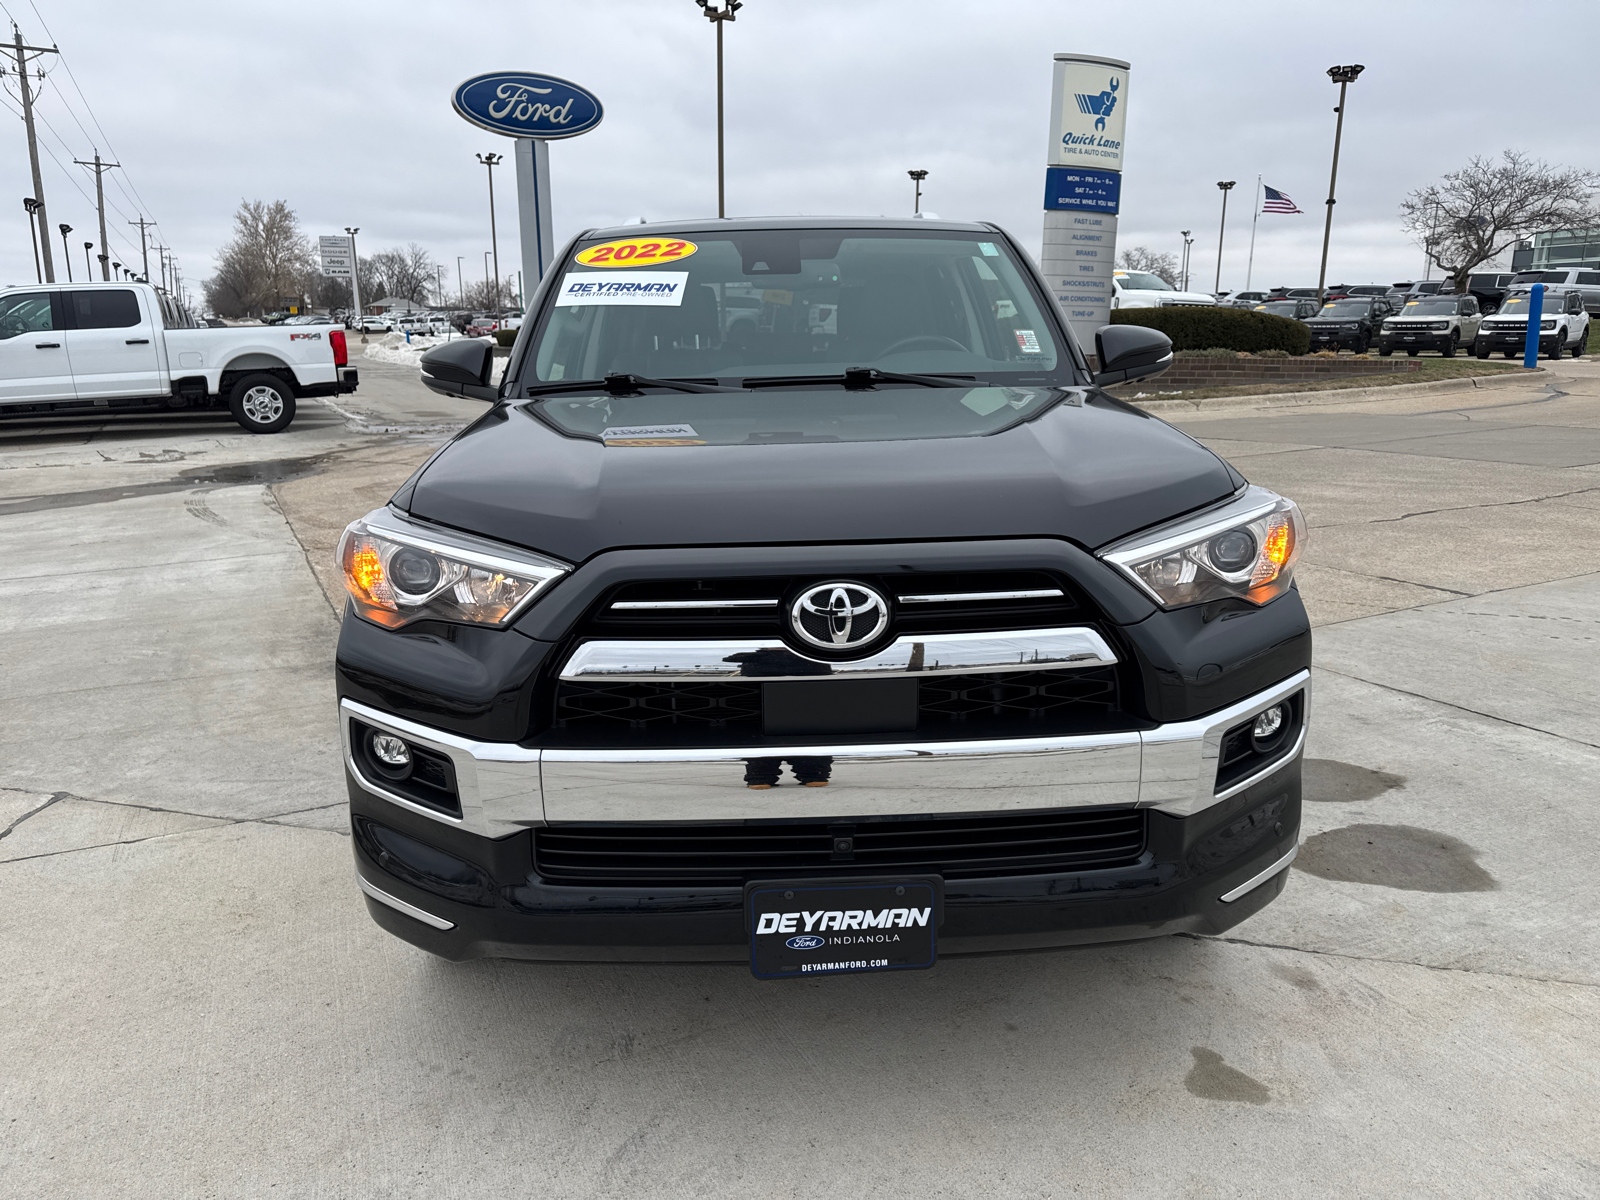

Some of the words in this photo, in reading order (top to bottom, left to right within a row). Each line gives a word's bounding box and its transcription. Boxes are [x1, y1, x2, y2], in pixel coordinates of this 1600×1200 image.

[488, 82, 574, 125] Ford
[1062, 132, 1097, 146] Quick
[1097, 135, 1121, 149] Lane
[1100, 150, 1119, 159] CENTER
[1058, 197, 1080, 205] SERVICE
[1072, 234, 1102, 242] ALIGNMENT
[587, 241, 687, 264] 2022
[327, 258, 345, 266] Jeep
[567, 282, 679, 293] DEYARMAN
[1062, 280, 1105, 288] SHOCKS/STRUTS
[1070, 295, 1105, 303] CONDITIONING
[290, 333, 321, 341] FX4
[756, 907, 932, 935] DEYARMAN
[793, 936, 818, 948] Ford
[829, 934, 901, 945] INDIANOLA
[801, 958, 889, 972] DEYARMANFORD.COM
